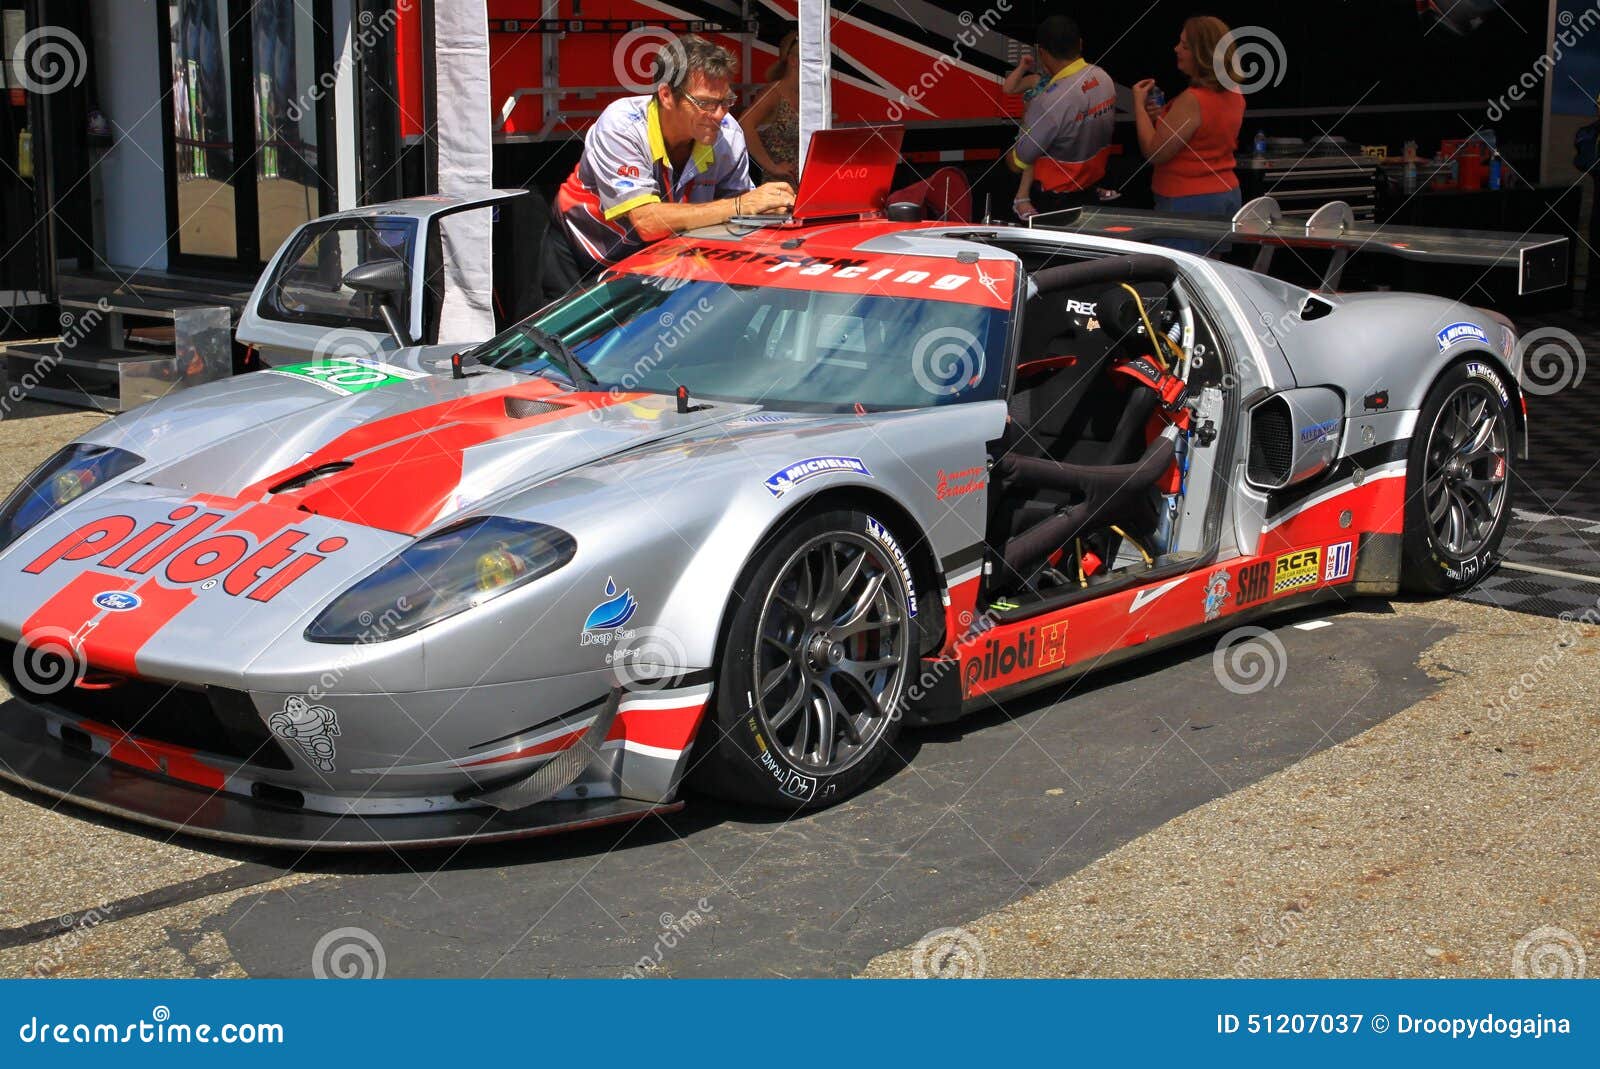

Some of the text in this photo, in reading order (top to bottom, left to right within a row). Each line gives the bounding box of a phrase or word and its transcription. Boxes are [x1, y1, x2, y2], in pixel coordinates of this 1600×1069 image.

[836, 167, 868, 180] VAIO
[765, 261, 972, 291] racing
[1447, 325, 1485, 340] MICHELIN
[1477, 364, 1509, 402] MICHELIN
[786, 459, 864, 480] MICHELIN
[21, 504, 349, 603] piloti
[1276, 551, 1318, 574] RCR
[881, 528, 918, 612] MICHELIN
[1236, 560, 1271, 606] SHR
[98, 592, 136, 609] Ford
[580, 626, 636, 646] Deep Sea
[963, 626, 1037, 699] piloti
[788, 776, 808, 796] 40
